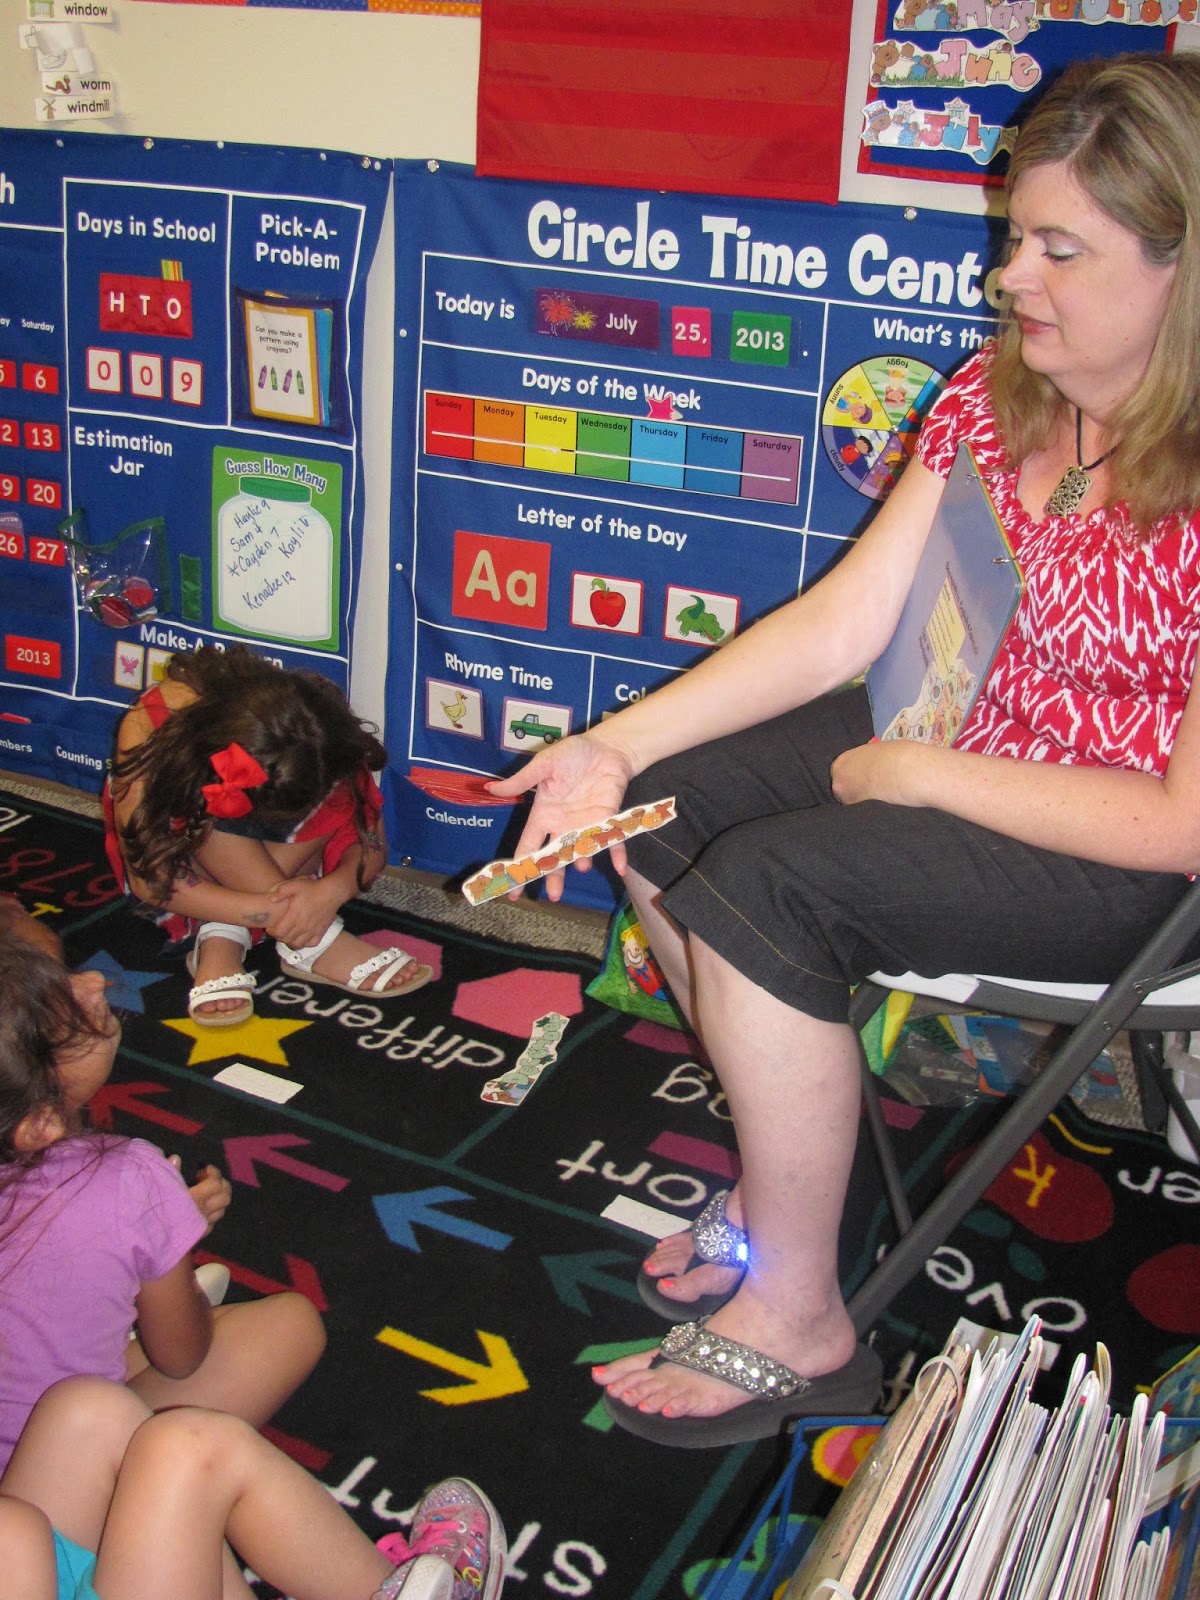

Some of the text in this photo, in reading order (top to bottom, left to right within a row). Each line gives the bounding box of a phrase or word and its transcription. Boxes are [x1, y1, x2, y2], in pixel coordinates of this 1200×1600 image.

[64, 3, 108, 16] window
[958, 0, 1035, 42] May
[934, 41, 1039, 87] June
[80, 79, 111, 91] worm
[67, 100, 110, 114] windmill
[920, 114, 1000, 163] July
[78, 212, 216, 243] Days in School
[261, 214, 338, 241] Pick-A-
[528, 200, 680, 271] Circle
[702, 215, 827, 289] Time
[256, 243, 340, 270] Problem
[110, 292, 125, 314] H
[139, 294, 151, 316] T
[22, 319, 55, 333] Saturday
[255, 325, 266, 333] Can
[280, 329, 296, 338] make
[435, 292, 494, 319] Today
[500, 299, 515, 319] is
[605, 313, 637, 335] July
[736, 327, 784, 351] 2013
[259, 336, 299, 349] pattern using
[874, 318, 952, 347] What's
[266, 345, 292, 354] crayons?
[886, 358, 909, 369] foggy
[35, 369, 47, 389] 6
[97, 361, 194, 392] 0 0 9
[522, 367, 571, 396] Days
[576, 375, 599, 396] of
[604, 378, 637, 400] the
[829, 383, 844, 405] sunny
[435, 399, 463, 411] Sunday
[483, 405, 515, 417] Monday
[534, 412, 567, 424] Tuesday
[581, 417, 628, 432] Wednesday
[32, 427, 53, 447] 13
[75, 427, 173, 457] Estimation
[640, 425, 679, 438] Thursday
[701, 433, 729, 444] Friday
[752, 439, 793, 453] Saturday
[110, 456, 144, 477] Jar
[830, 449, 846, 473] cloudy
[226, 458, 328, 493] Guess How Many
[33, 484, 55, 504] 20
[518, 503, 687, 551] Letter of the Day
[36, 541, 58, 562] 27
[230, 533, 255, 552] Sam
[465, 549, 537, 608] Aa
[16, 648, 51, 666] 2013
[445, 652, 553, 691] Rhyme Time
[0, 739, 33, 752] mbers
[56, 746, 103, 770] Counting
[426, 807, 494, 828] Calendar
[254, 976, 505, 1069] differe
[556, 1139, 714, 1208] ort
[924, 1245, 1088, 1333] ove
